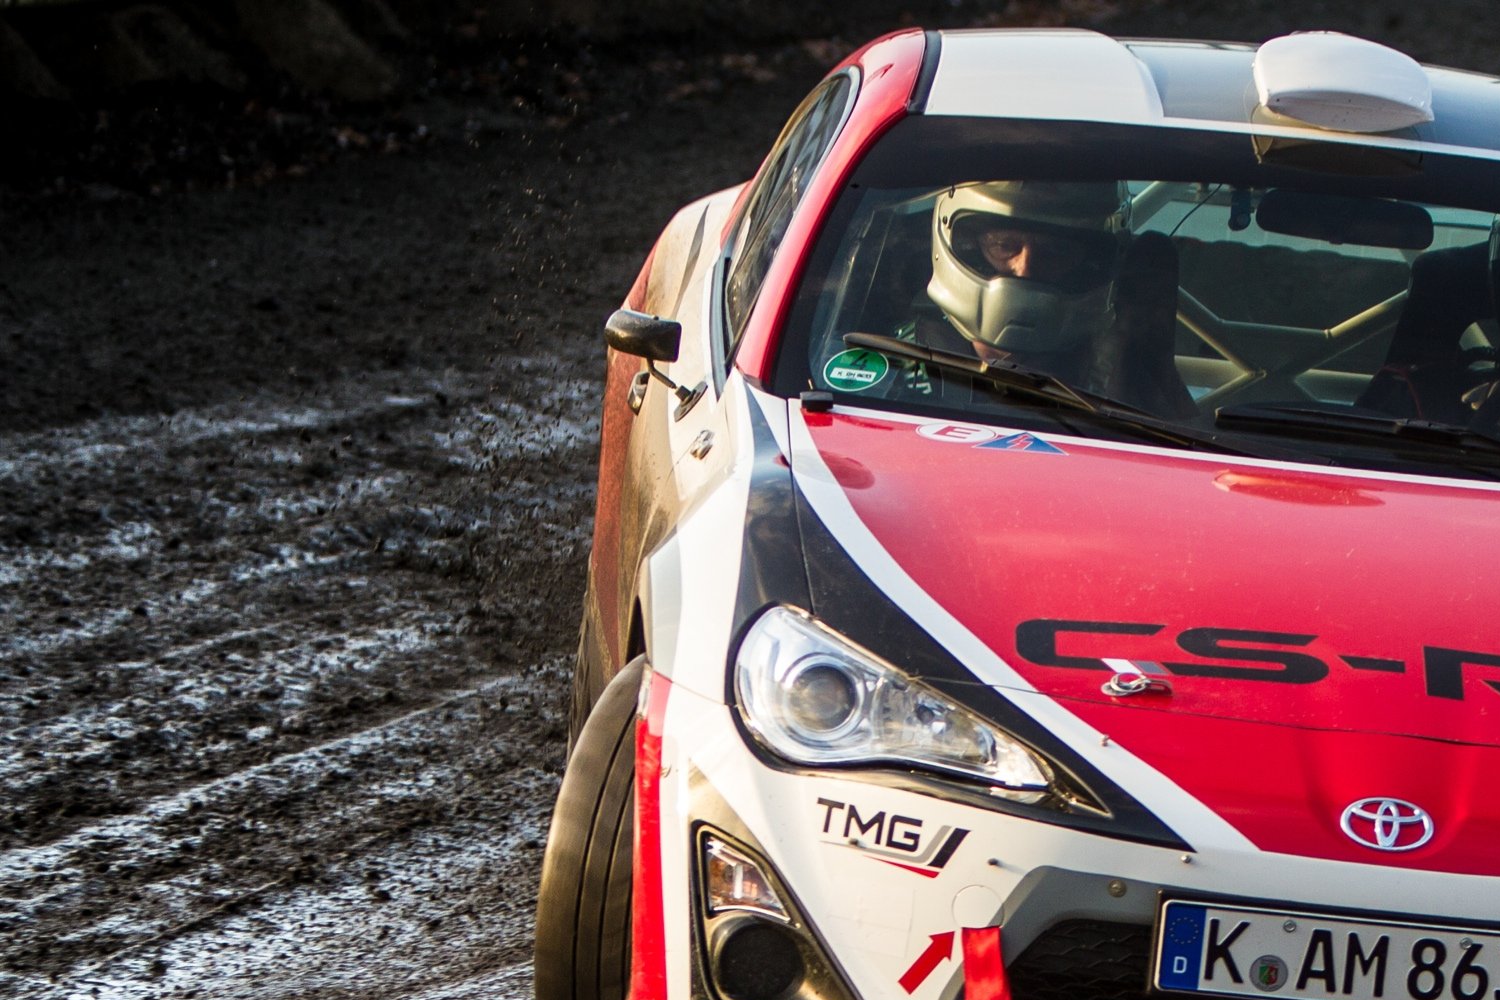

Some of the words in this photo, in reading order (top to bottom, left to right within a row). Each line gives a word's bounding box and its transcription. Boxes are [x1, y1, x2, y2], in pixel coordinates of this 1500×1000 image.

[933, 425, 981, 439] E
[816, 796, 924, 853] TMG
[1172, 955, 1188, 974] D
[1203, 917, 1251, 985] K
[1295, 927, 1391, 998] AM
